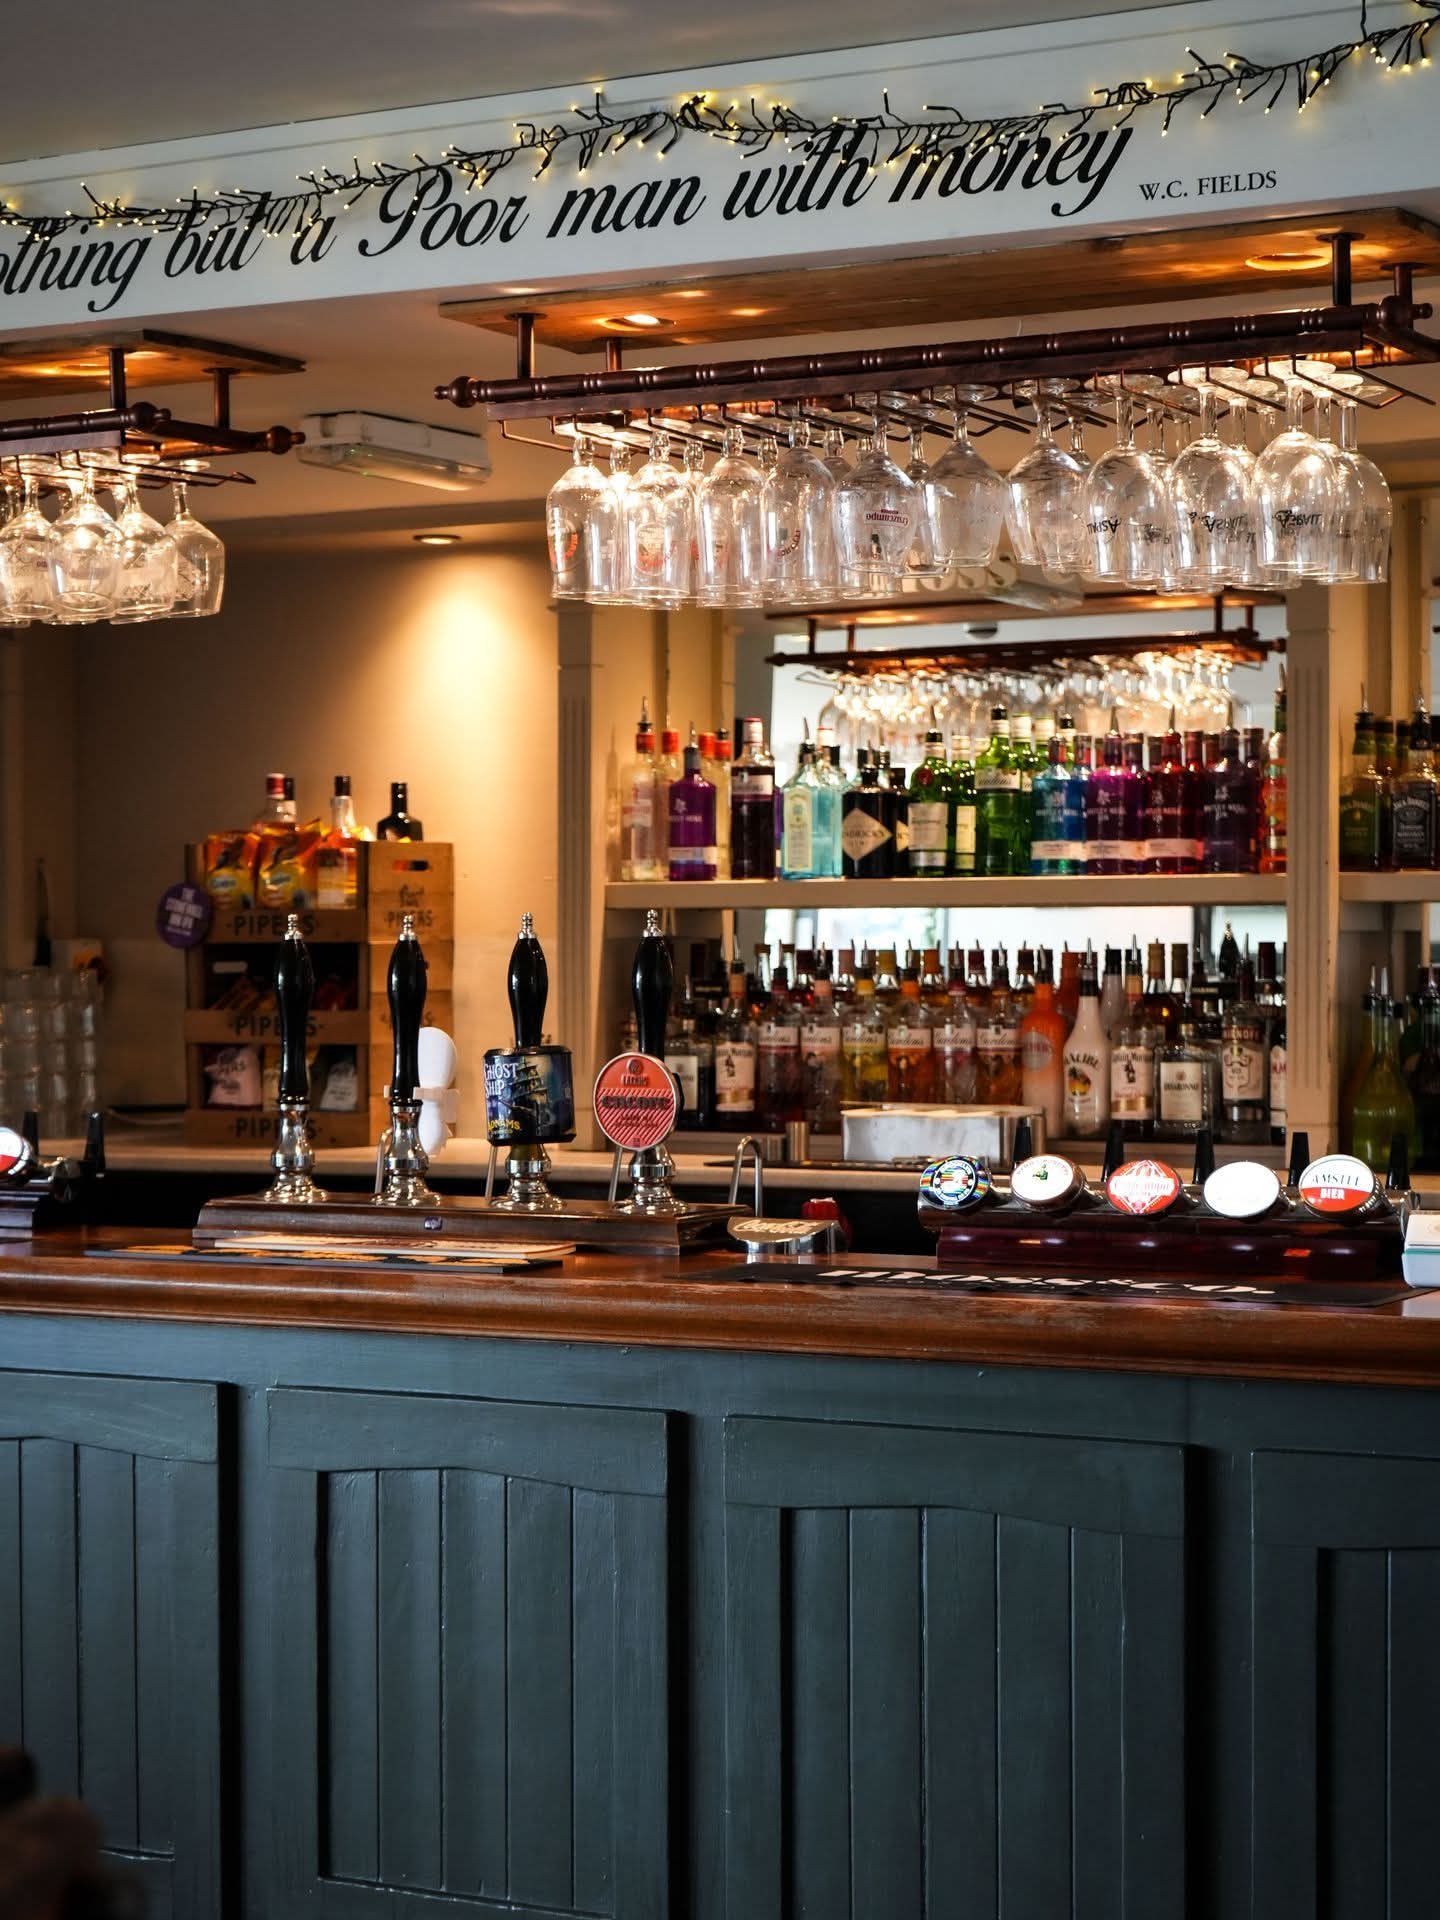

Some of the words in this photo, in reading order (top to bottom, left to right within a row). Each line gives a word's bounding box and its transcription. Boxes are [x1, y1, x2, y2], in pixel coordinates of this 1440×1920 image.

[1139, 181, 1188, 200] W.C.
[1197, 170, 1277, 196] FIELDS
[164, 190, 264, 277] but
[290, 215, 337, 265] a
[358, 166, 530, 257] Poor
[546, 176, 707, 238] man
[723, 124, 877, 220] with
[888, 128, 1133, 216] money
[234, 914, 316, 936] PIPES
[236, 1014, 318, 1037] PIPES
[484, 1063, 518, 1080] GHOST
[485, 1080, 505, 1098] SHIP
[235, 1117, 317, 1139] PIPS
[1320, 1188, 1345, 1200] BIER
